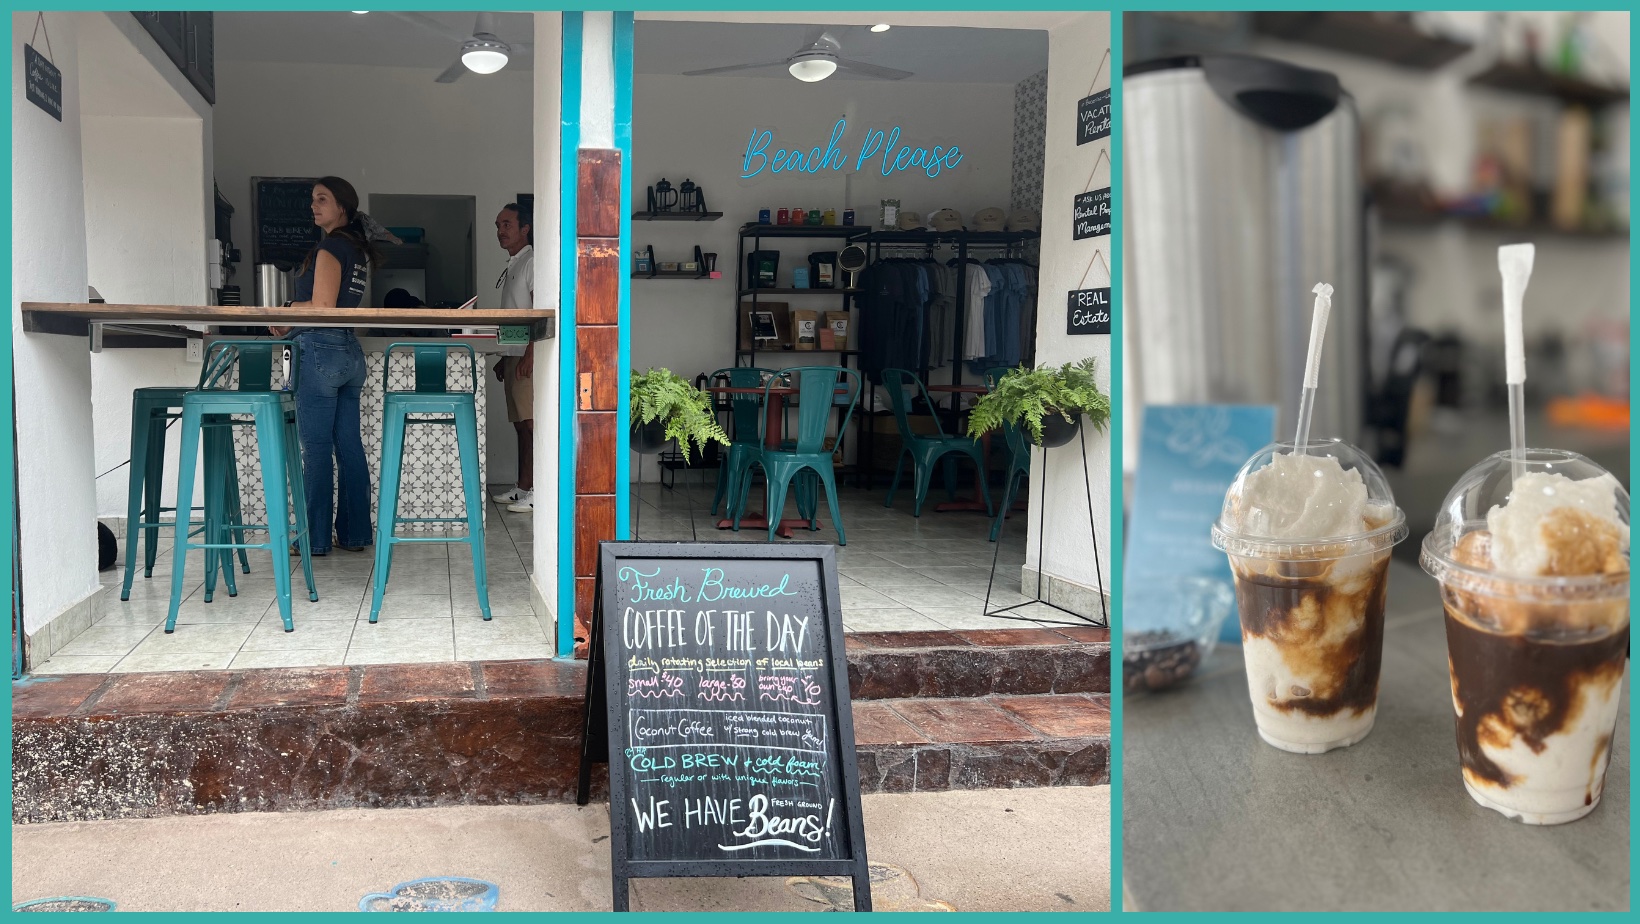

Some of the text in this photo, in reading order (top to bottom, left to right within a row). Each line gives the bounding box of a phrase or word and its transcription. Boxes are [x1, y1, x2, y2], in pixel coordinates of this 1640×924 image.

[741, 119, 964, 178] Beach Please
[1094, 193, 1102, 202] US
[1074, 205, 1098, 221] Rental
[1078, 292, 1108, 307] REAL
[1072, 309, 1110, 326] Estate
[619, 567, 797, 602] Fresh Brewed
[624, 607, 809, 653] COFFEE OF THE DAY
[628, 655, 660, 674] daily
[662, 657, 703, 672] rotating
[756, 658, 769, 666] of
[771, 658, 793, 667] local
[796, 658, 823, 668] beans
[758, 675, 799, 686] bring your
[778, 685, 792, 694] cup
[746, 714, 774, 723] blended
[778, 716, 812, 725] coconut
[635, 716, 714, 740] Coconut Coffee
[724, 724, 733, 734] w/
[780, 729, 800, 737] brew
[631, 753, 676, 772] COLD
[682, 754, 738, 768] BREW
[756, 755, 785, 767] cold
[786, 756, 826, 773] foam!
[661, 774, 695, 788] regular
[712, 773, 732, 781] with
[735, 774, 769, 787] unique
[772, 776, 798, 787] flavors
[771, 798, 822, 810] FRESH GROUND
[632, 794, 834, 841] WE HAVE Beans!
